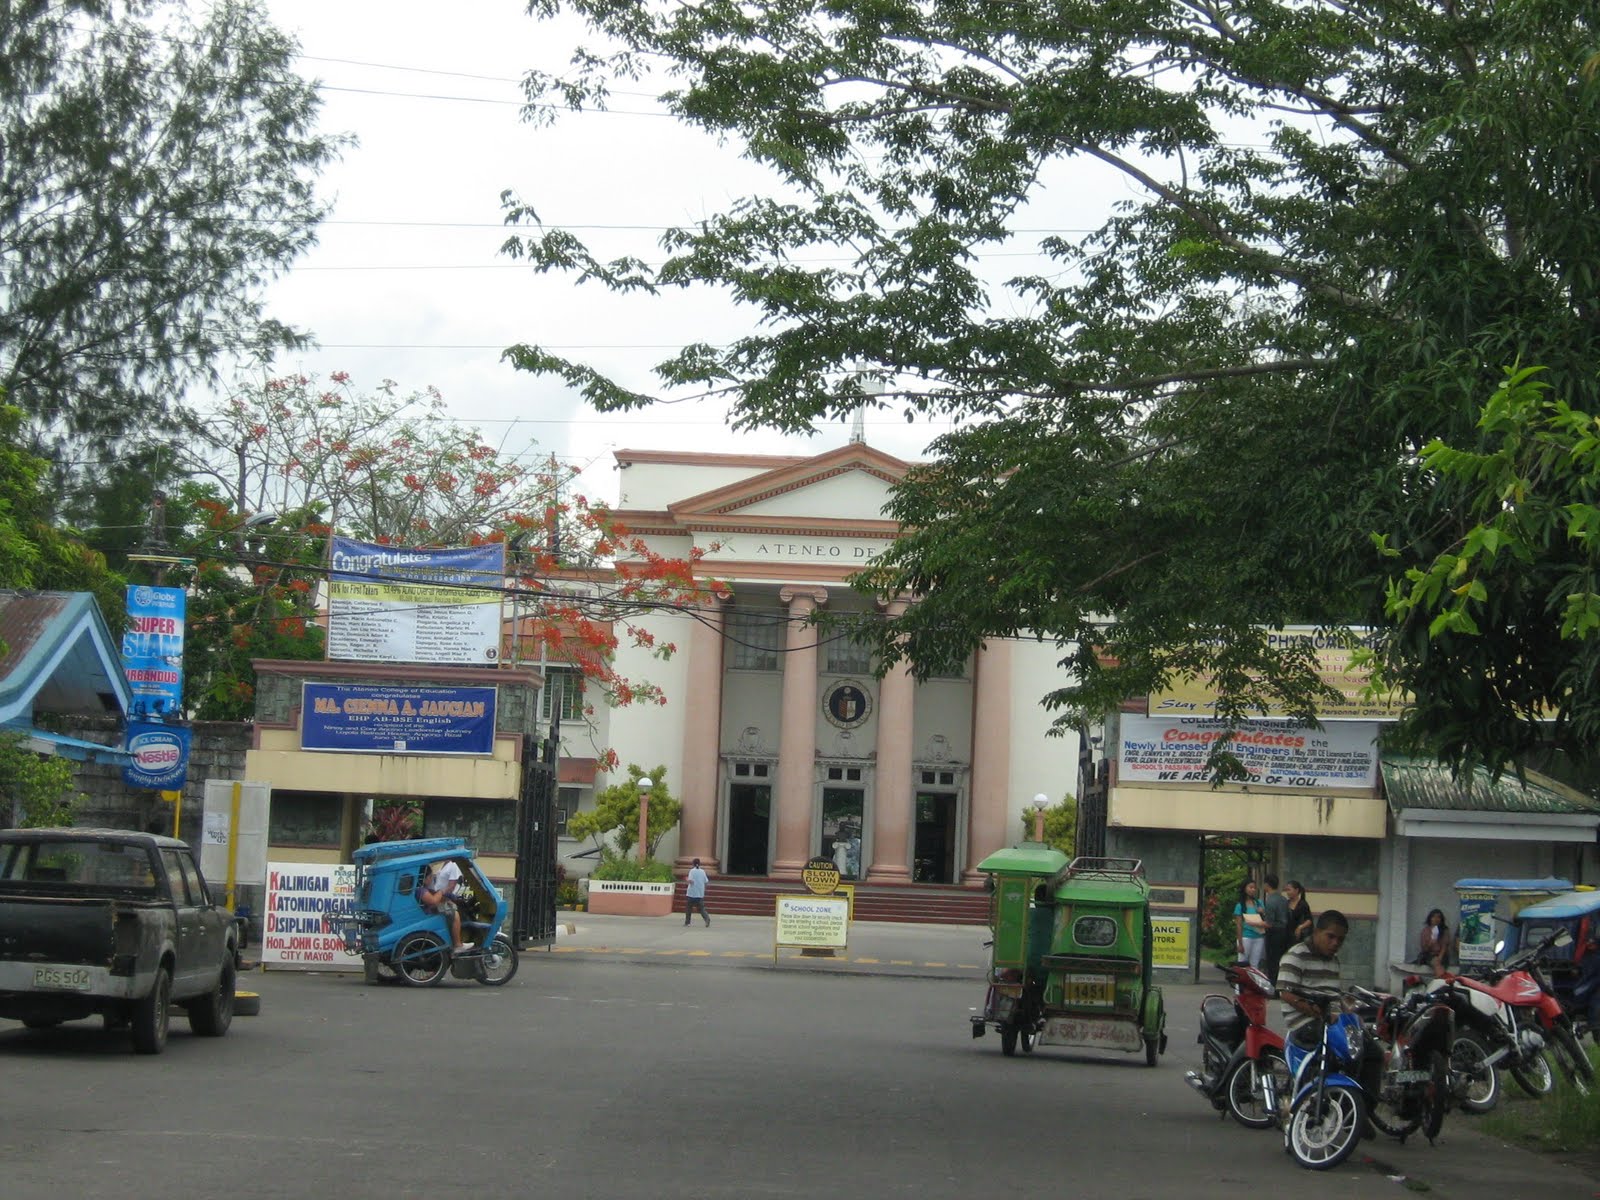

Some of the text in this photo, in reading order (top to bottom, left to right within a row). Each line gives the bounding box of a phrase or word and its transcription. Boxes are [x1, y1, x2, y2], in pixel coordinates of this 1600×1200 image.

[756, 543, 876, 558] ATENEO DE
[332, 551, 432, 573] Congratulates
[152, 591, 176, 601] Globe
[342, 583, 350, 593] for
[350, 584, 360, 595] First
[362, 585, 379, 596] Takers
[134, 616, 175, 634] SUPER
[123, 632, 181, 658] SLAM
[1268, 634, 1345, 650] PHYSICAL
[314, 697, 341, 714] MA.
[401, 699, 417, 716] A.
[419, 700, 485, 718] JAUCIAN
[1156, 699, 1197, 711] Stay
[1321, 708, 1360, 716] Personnel
[416, 717, 452, 725] English
[1250, 719, 1318, 729] ENGINEERIN
[1259, 726, 1298, 735] University
[1163, 728, 1328, 748] Congrtulates the
[1124, 740, 1290, 757] Newly Licensed Cvil Engineers
[1193, 764, 1211, 772] RAT
[1270, 769, 1301, 777] NATIONAL
[1158, 771, 1178, 780] WE
[1182, 771, 1209, 781] ARE
[1214, 771, 1261, 783] ROUD
[1265, 775, 1282, 784] OF
[808, 861, 834, 870] CAUTION
[270, 871, 329, 892] KALINIGAN
[805, 876, 836, 884] DOWN
[334, 885, 356, 893] smil
[268, 892, 354, 914] KATONINONGAN
[790, 905, 832, 914] SCHOOL ZONE
[267, 912, 320, 934] DISIPLINA
[1152, 926, 1181, 934] ANCE
[287, 936, 311, 950] JOHN
[313, 938, 322, 950] G.
[1153, 936, 1176, 944] ITORS
[280, 950, 333, 961] CITY MAYOR
[35, 970, 61, 984] PGS
